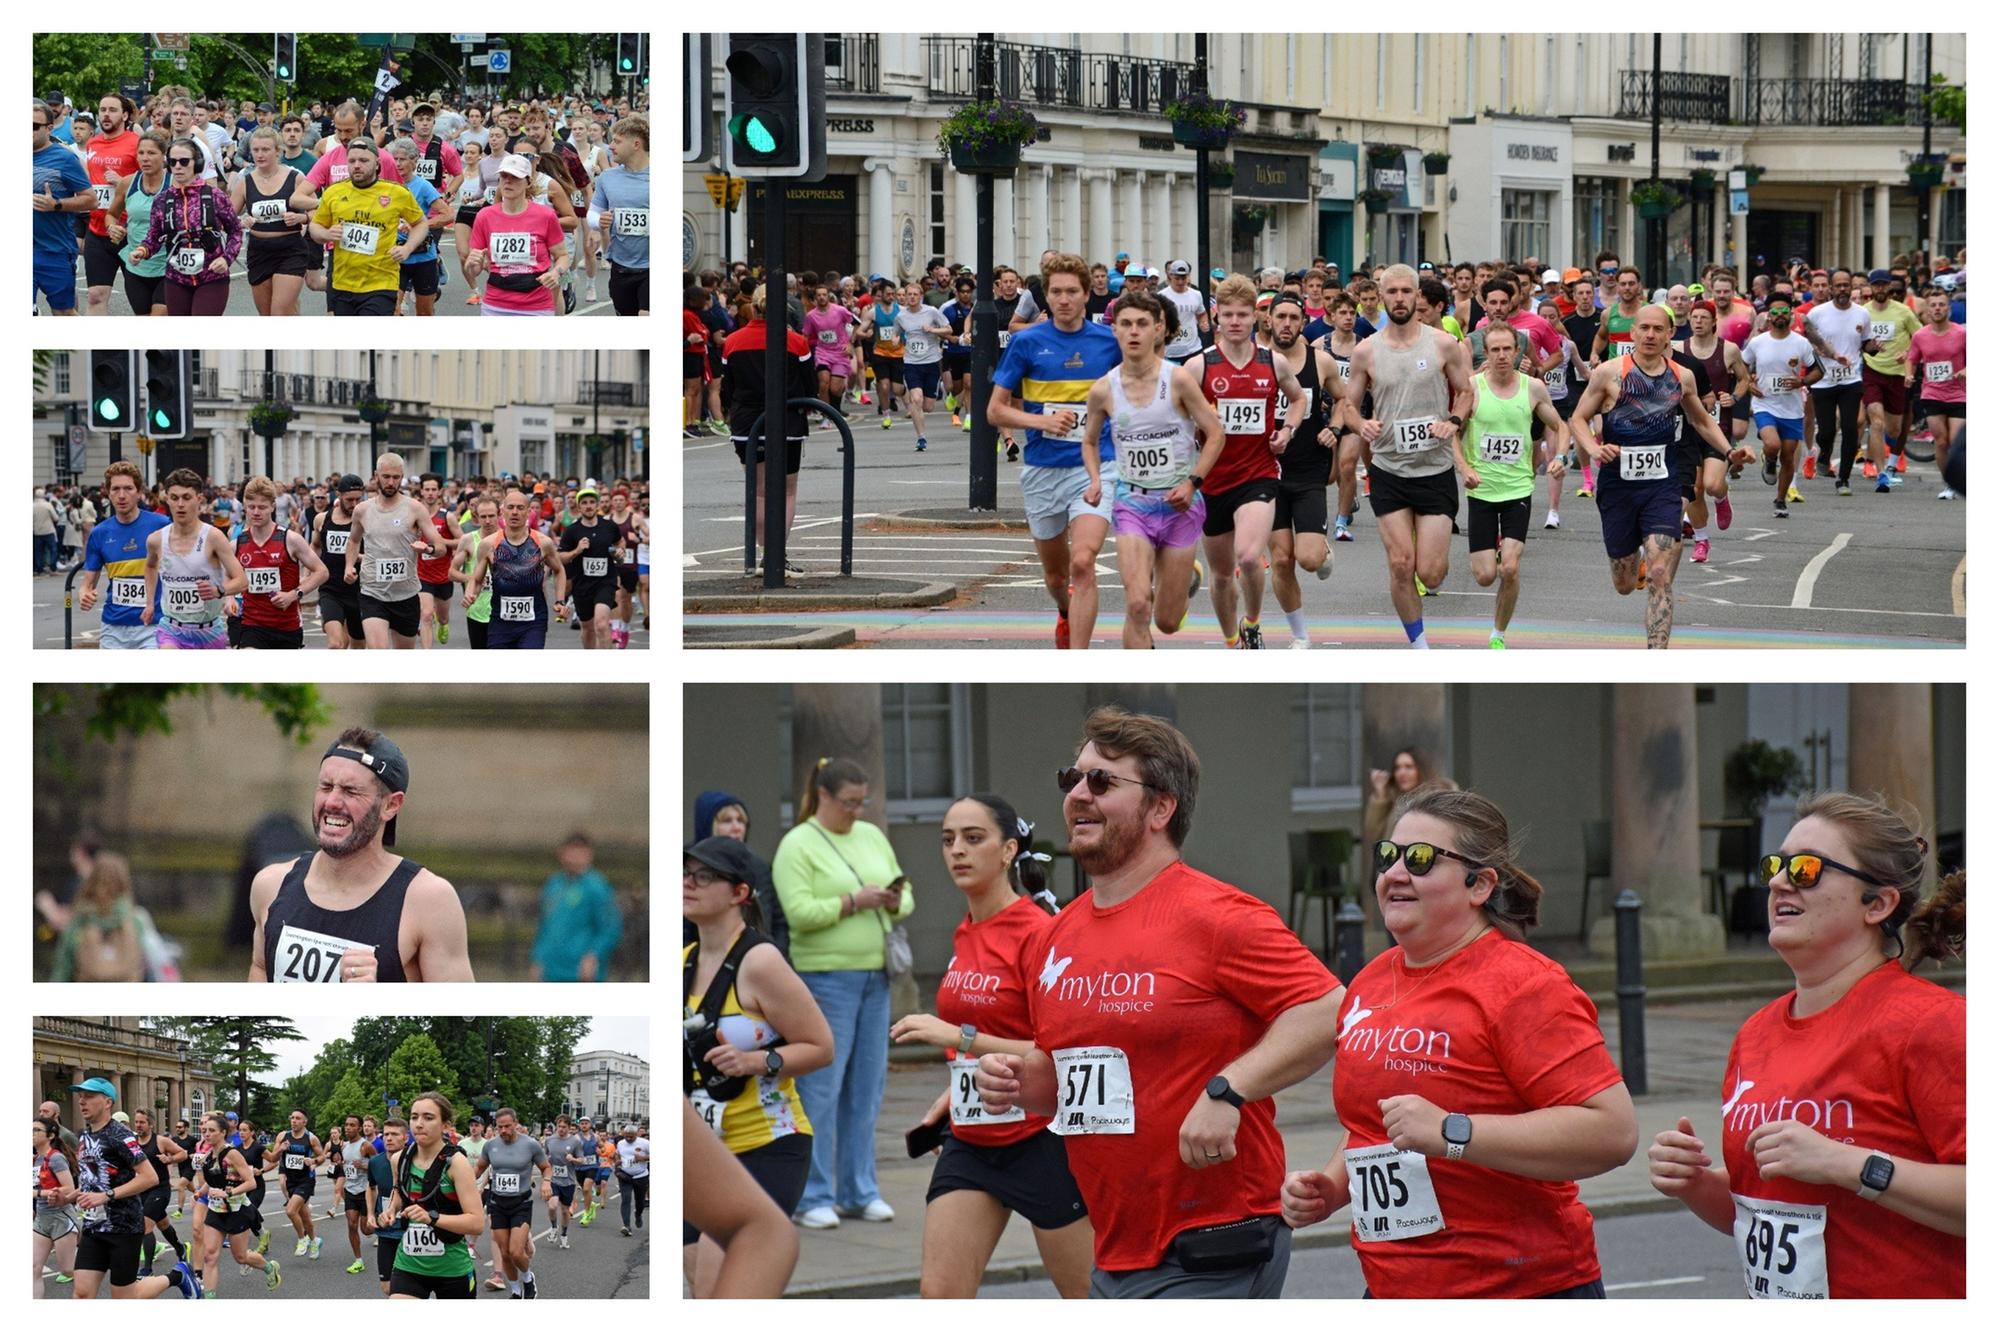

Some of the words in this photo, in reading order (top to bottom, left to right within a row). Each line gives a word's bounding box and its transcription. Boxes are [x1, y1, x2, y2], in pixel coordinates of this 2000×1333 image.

[417, 163, 433, 174] 666
[259, 204, 279, 217] 200
[619, 213, 647, 227] 1533
[347, 228, 370, 245] 404
[496, 238, 526, 253] 1282
[1225, 406, 1260, 423] 1495
[1487, 438, 1519, 454] 1452
[1128, 448, 1168, 468] 2005
[1628, 452, 1661, 469] 1590
[329, 535, 347, 547] 207
[381, 563, 405, 575] 1582
[586, 561, 606, 571] 1657
[250, 572, 277, 585] 1495
[117, 583, 145, 598] 1384
[169, 590, 199, 604] 2005
[505, 601, 530, 613] 1590
[284, 943, 343, 982] 207
[943, 970, 1000, 994] myton
[1059, 971, 1155, 1006] myton
[959, 991, 997, 1006] hospice
[1098, 999, 1154, 1015] hospice
[1345, 1026, 1450, 1060] myton
[1384, 1055, 1448, 1077] hospice
[1065, 1064, 1105, 1107] 571
[1091, 1116, 1130, 1127] Raceways
[498, 1177, 517, 1187] 1644
[1356, 1162, 1409, 1212] 705
[1396, 1214, 1438, 1229] Raceways
[1774, 1209, 1806, 1219] Marathon
[407, 1230, 438, 1246] 1160
[1746, 1217, 1799, 1274] 695
